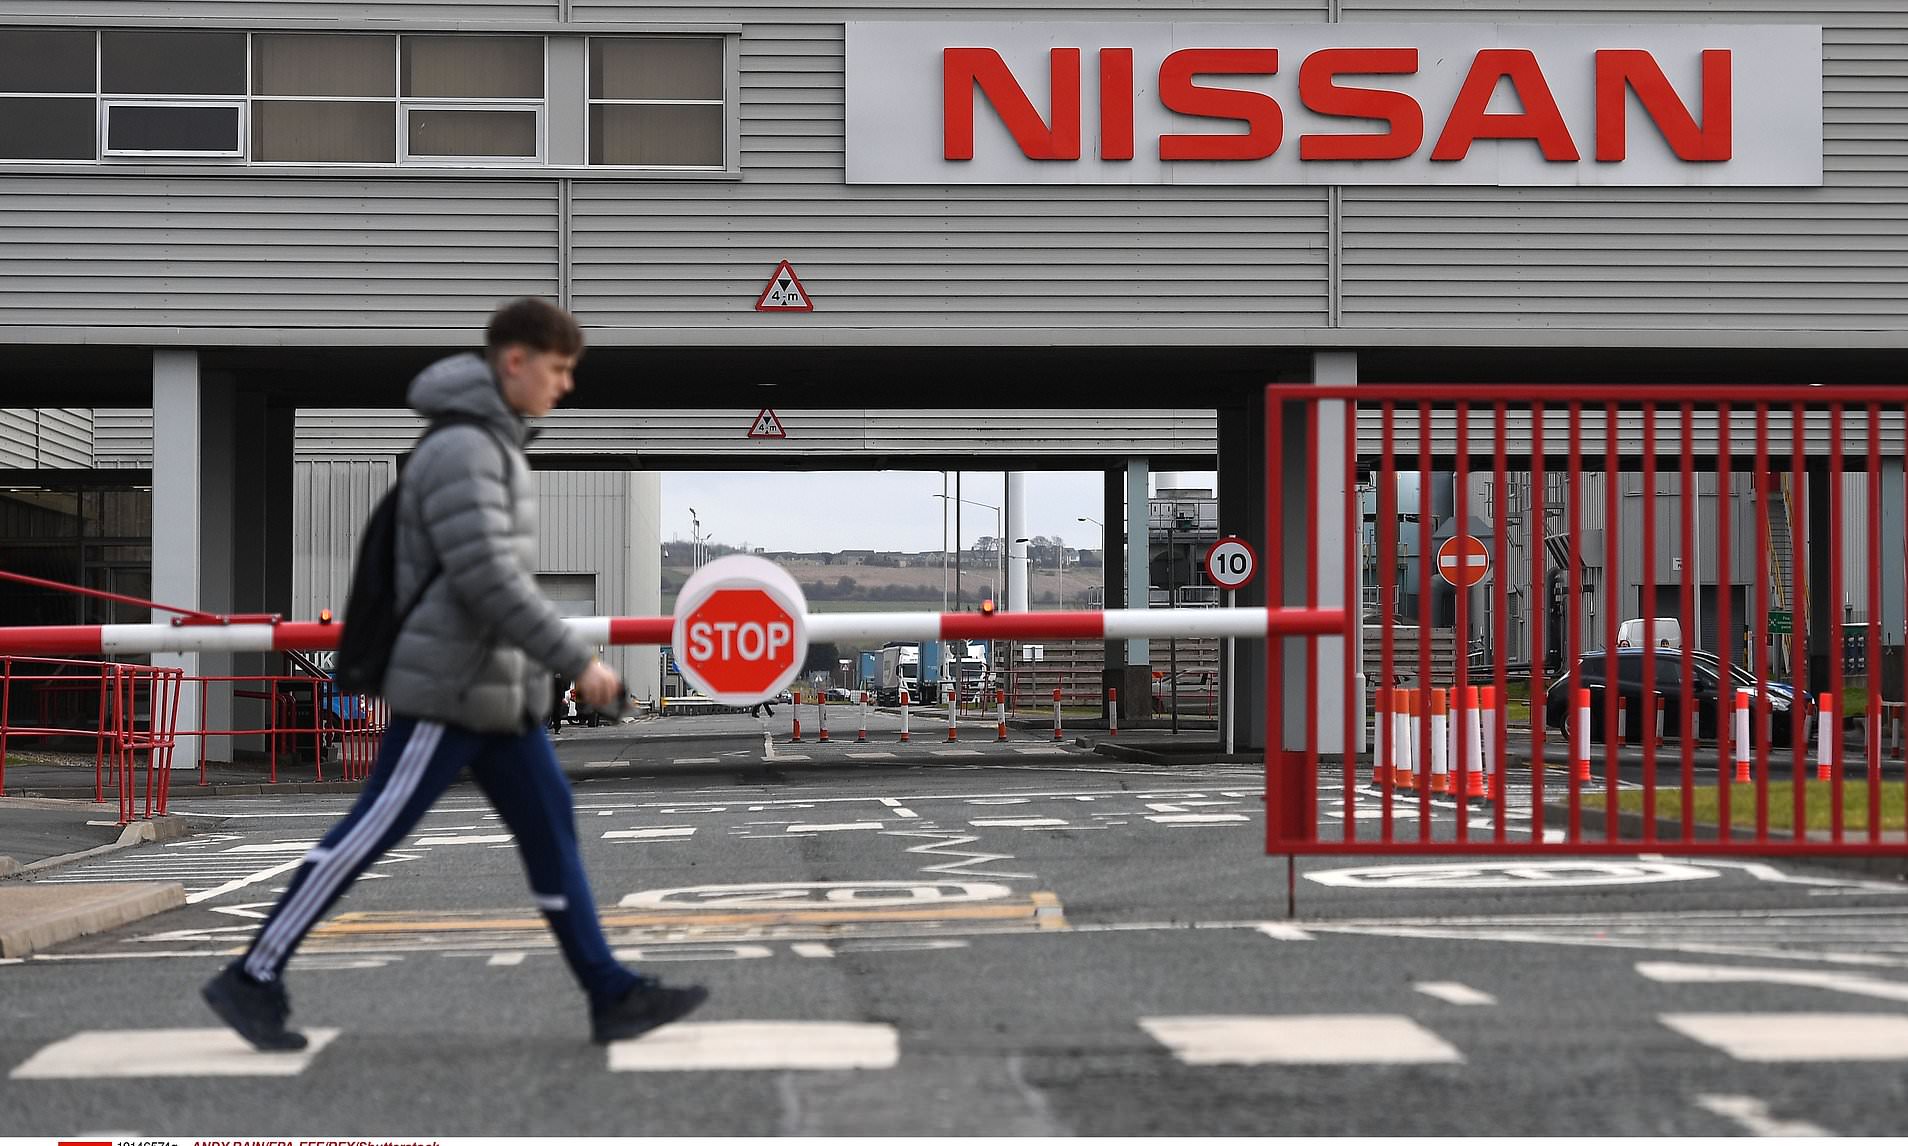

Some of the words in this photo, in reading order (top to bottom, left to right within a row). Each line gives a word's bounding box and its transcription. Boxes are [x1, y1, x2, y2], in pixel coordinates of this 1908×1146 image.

[943, 47, 1732, 162] NISSAN
[1217, 552, 1247, 575] 10
[689, 621, 792, 661] STOP
